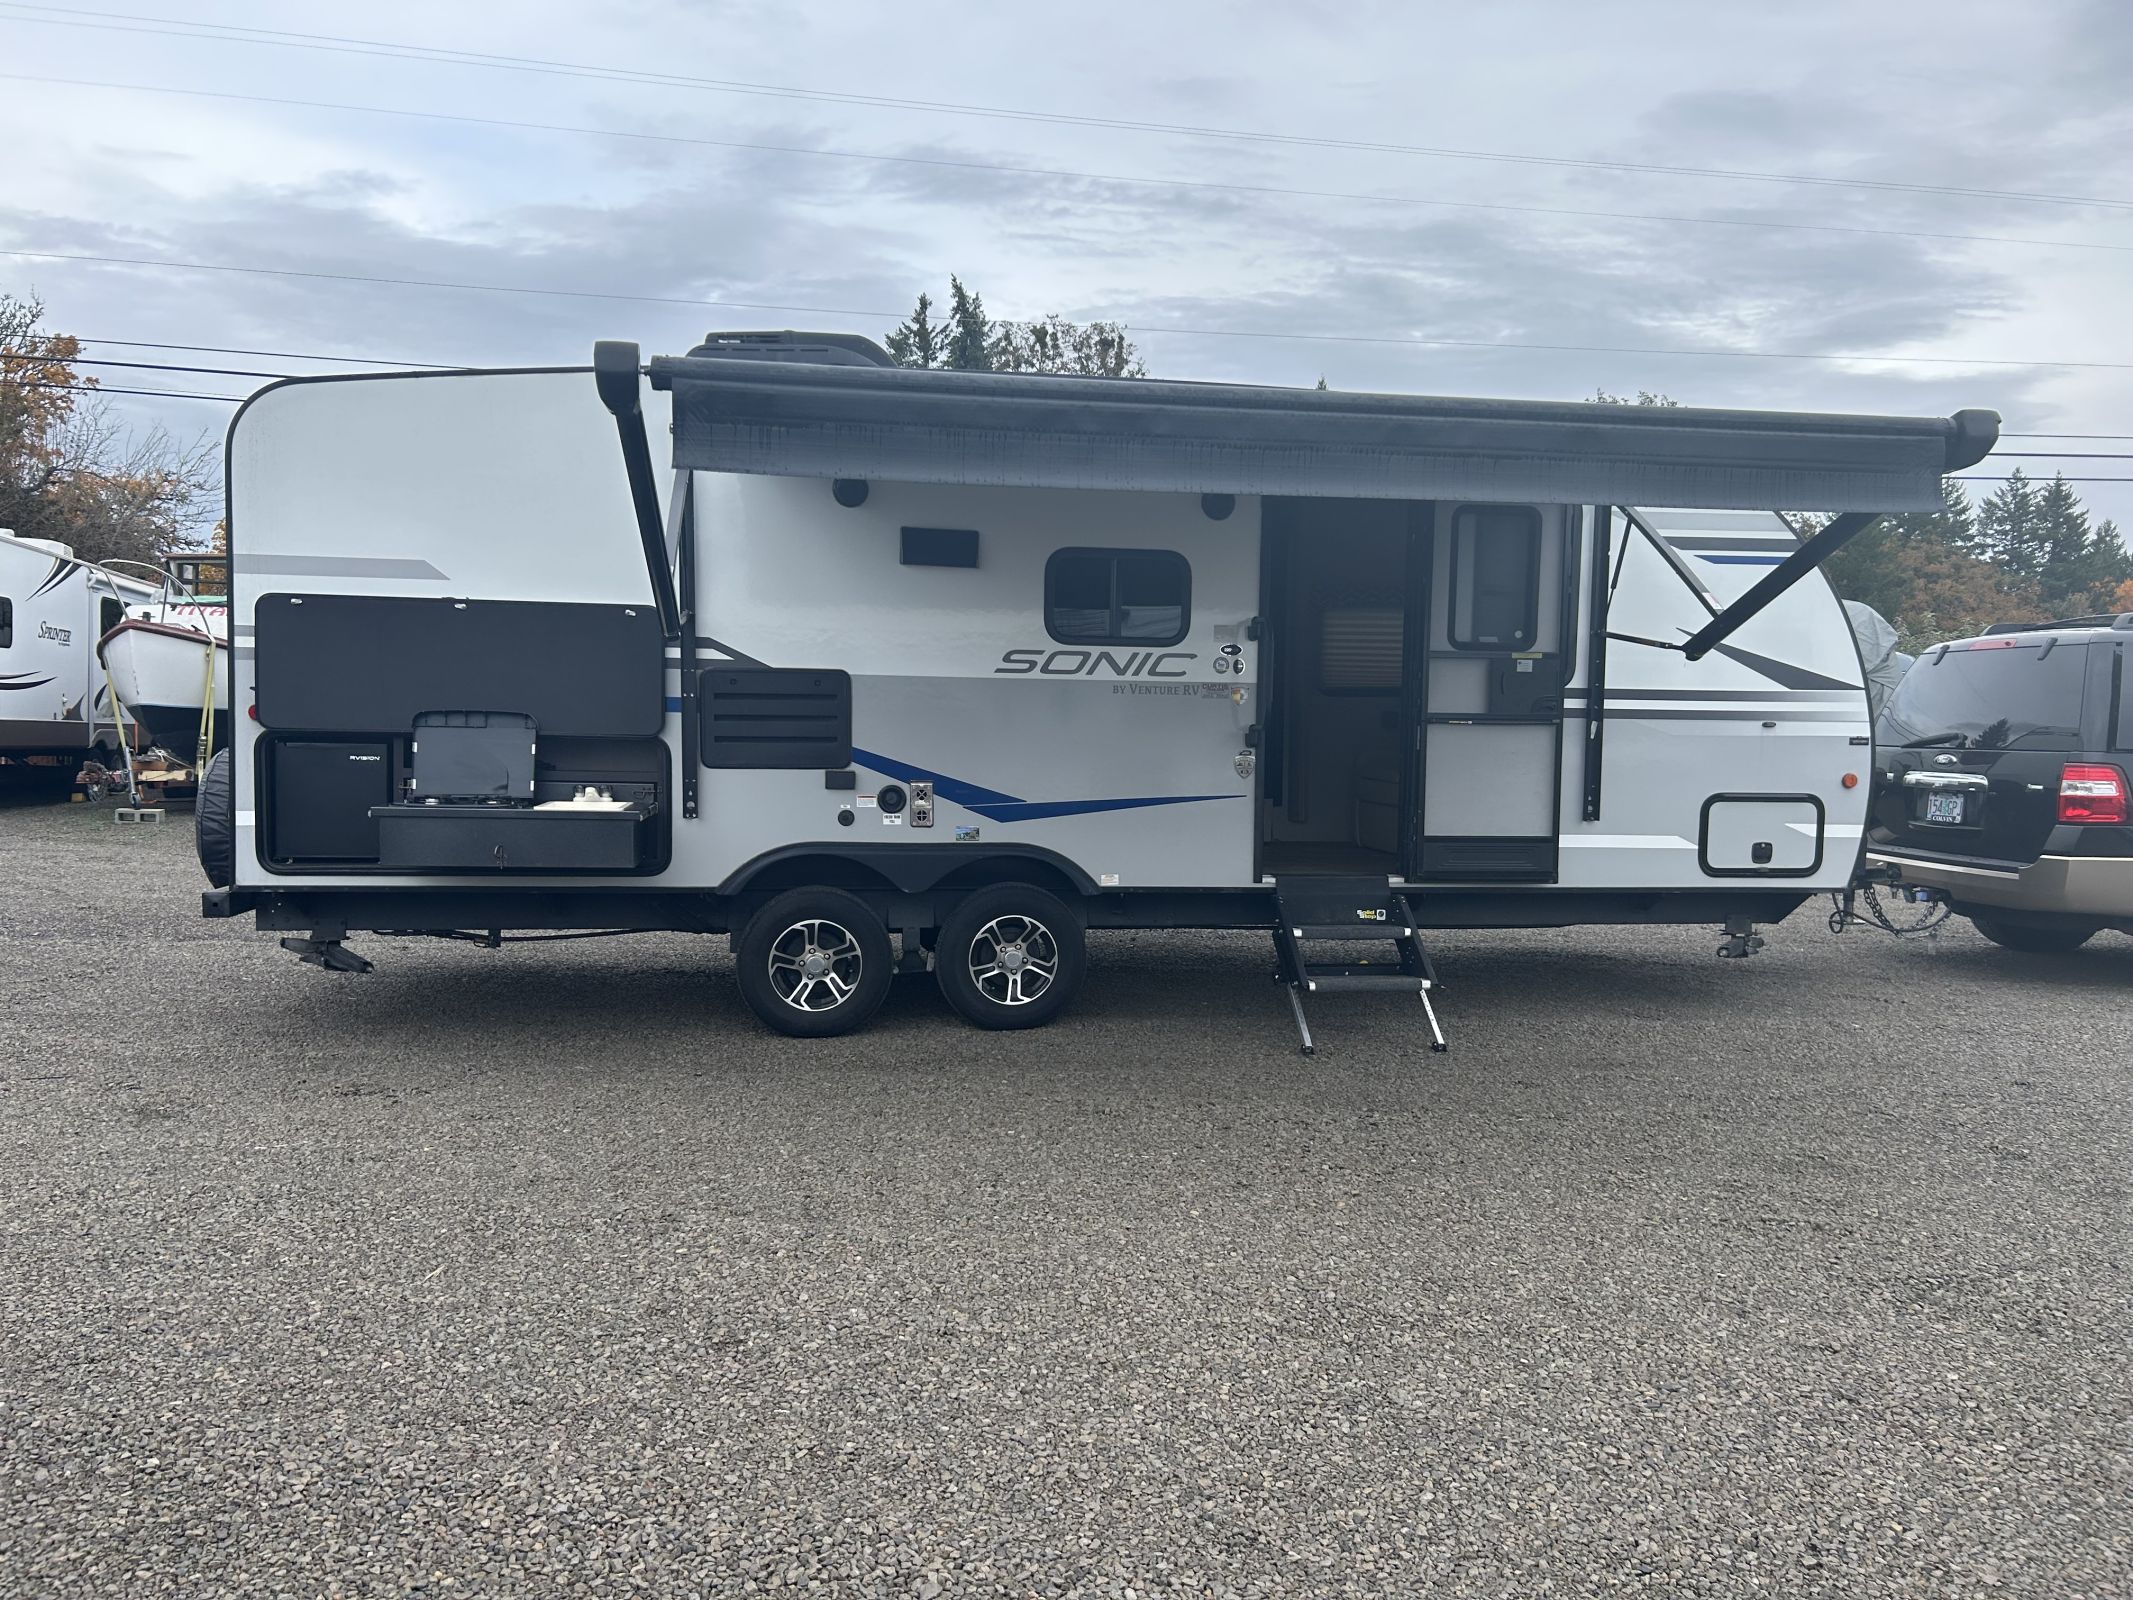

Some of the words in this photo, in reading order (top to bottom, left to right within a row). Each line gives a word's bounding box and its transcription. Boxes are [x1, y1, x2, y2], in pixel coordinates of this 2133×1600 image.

[177, 605, 227, 616] TITA
[38, 621, 71, 642] SPRINTER
[994, 649, 1198, 677] SONIC
[1113, 685, 1126, 694] BY
[1129, 683, 1180, 695] VENTURE
[1182, 684, 1200, 696] RV
